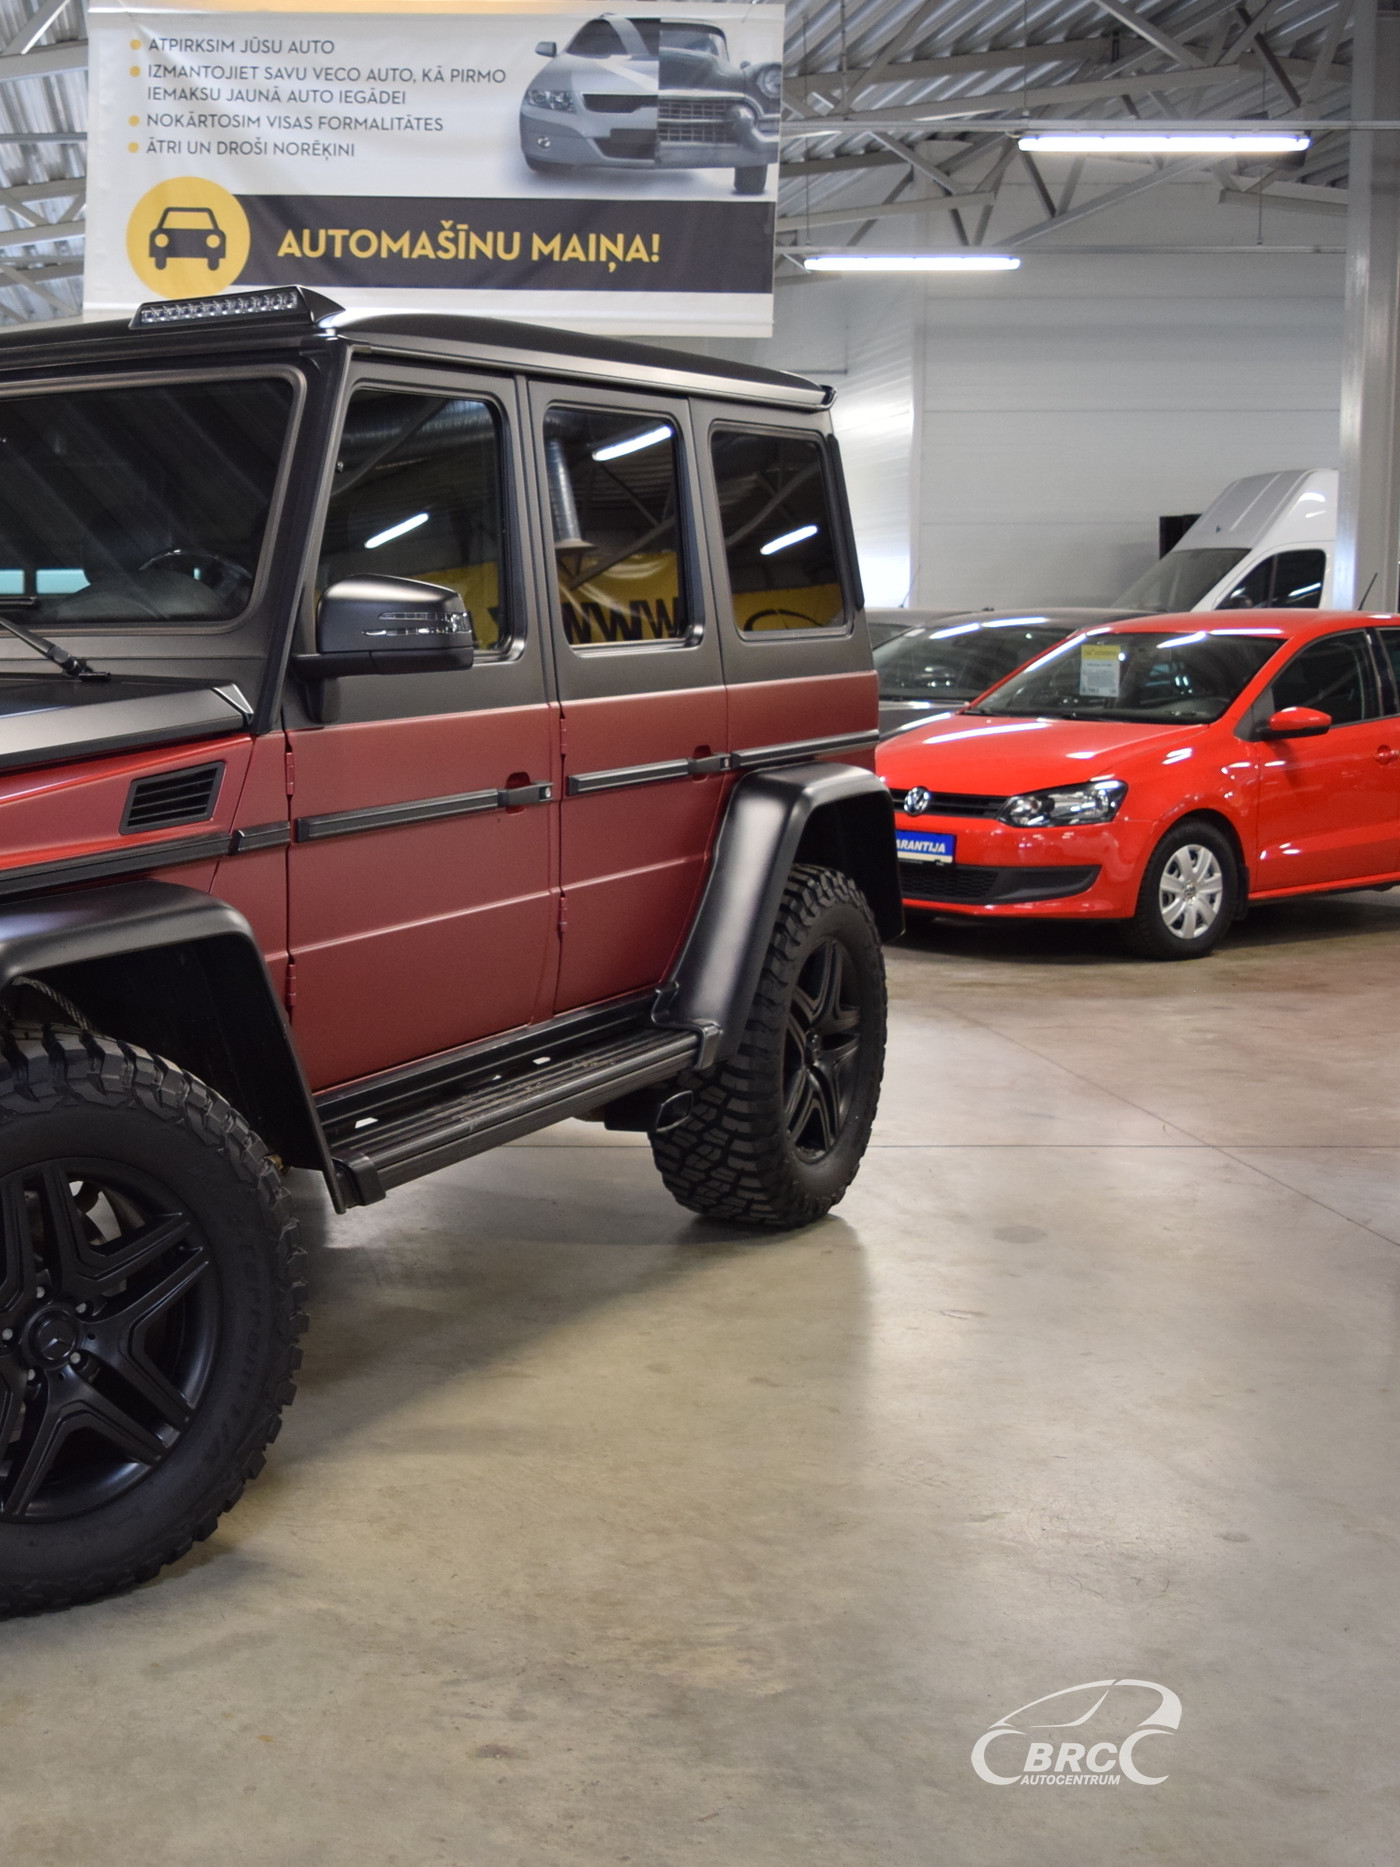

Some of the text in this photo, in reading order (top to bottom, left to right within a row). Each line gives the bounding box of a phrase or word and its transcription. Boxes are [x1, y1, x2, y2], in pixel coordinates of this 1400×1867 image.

[148, 36, 335, 54] ATPIRKSIM JŪSU AUTO
[148, 64, 507, 84] IZMANTOJIET SAVU VECO AUTO, KĀ PIRMO
[147, 86, 406, 105] IEMAKSU JAUNĀ AUTO IEGĀDEI
[146, 111, 444, 131] NOKĀRTOSIM VISAS FORMALITĀTES
[146, 137, 355, 160] ĀTRI UN DROŠI NORĒĶINI
[276, 219, 660, 273] AUTOMAŠĪNU MAIŅA!
[895, 838, 946, 854] ARANTIJA
